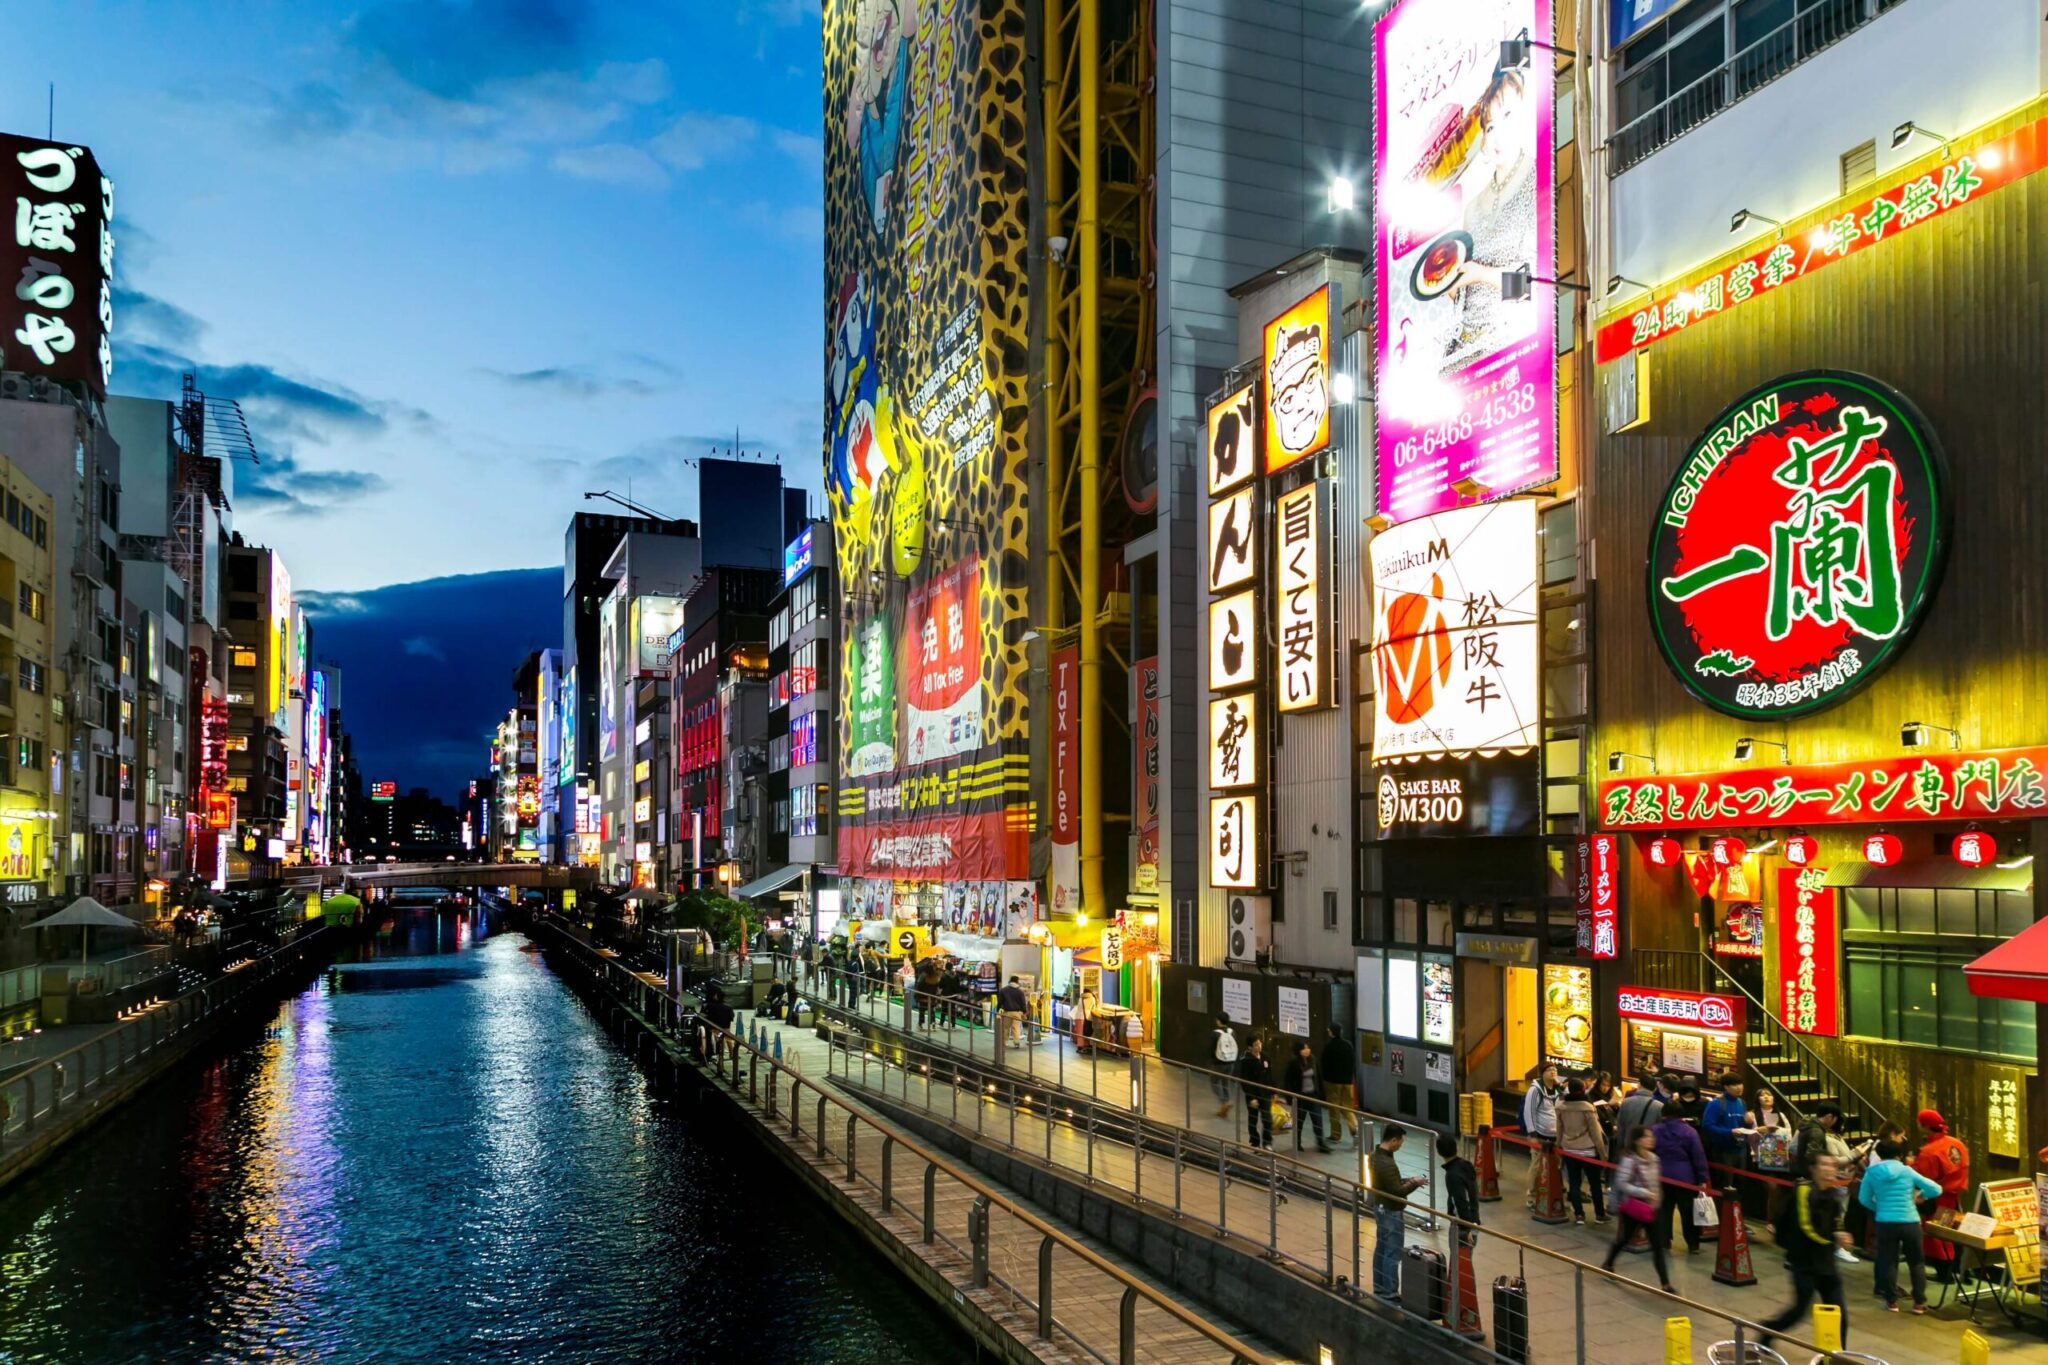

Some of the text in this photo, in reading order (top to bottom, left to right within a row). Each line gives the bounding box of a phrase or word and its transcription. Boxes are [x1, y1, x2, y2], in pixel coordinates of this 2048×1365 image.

[1394, 383, 1536, 468] 06-6468-4538
[1664, 393, 1780, 529] ICHIRAN
[1661, 405, 1904, 641] 一蘭
[1284, 493, 1313, 703] 旨くて安い
[922, 600, 964, 666] 免税
[1462, 590, 1504, 714] 松阪牛
[923, 664, 964, 694] All Tax Free
[1735, 649, 1862, 708] 昭和35年創業
[1058, 662, 1069, 832] Tax Free
[1399, 796, 1463, 822] M300
[1400, 779, 1462, 796] SAKE BAR
[1604, 757, 2047, 826] 天然とんこつラーメン専門店
[1786, 836, 1806, 864] 一蘭
[1867, 836, 1888, 864] 一蘭
[1958, 834, 1982, 863] 一蘭
[1576, 843, 1592, 951] ラーメン 一蘭
[1595, 838, 1615, 957] ラーメン 一蘭
[1620, 994, 1728, 1020] お土産販売所 はい
[2003, 1080, 2017, 1144] 24時間営業
